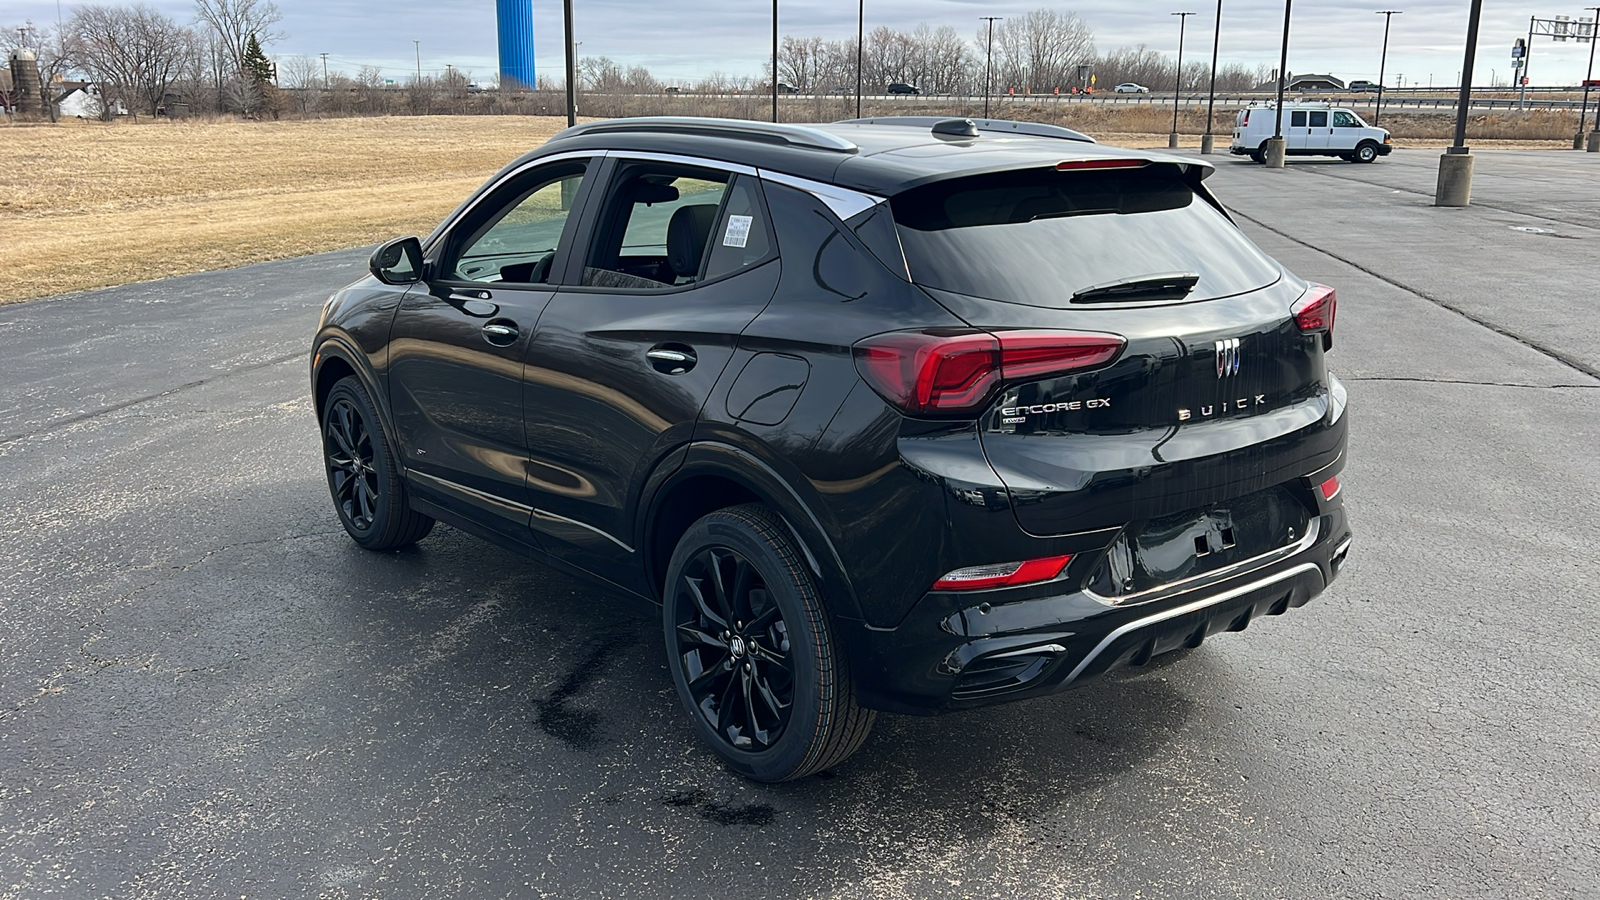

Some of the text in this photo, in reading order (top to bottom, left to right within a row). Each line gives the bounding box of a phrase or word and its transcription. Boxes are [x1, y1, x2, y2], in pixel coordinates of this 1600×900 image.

[1002, 398, 1111, 416] ENCORE GX
[1178, 394, 1266, 421] BUICK
